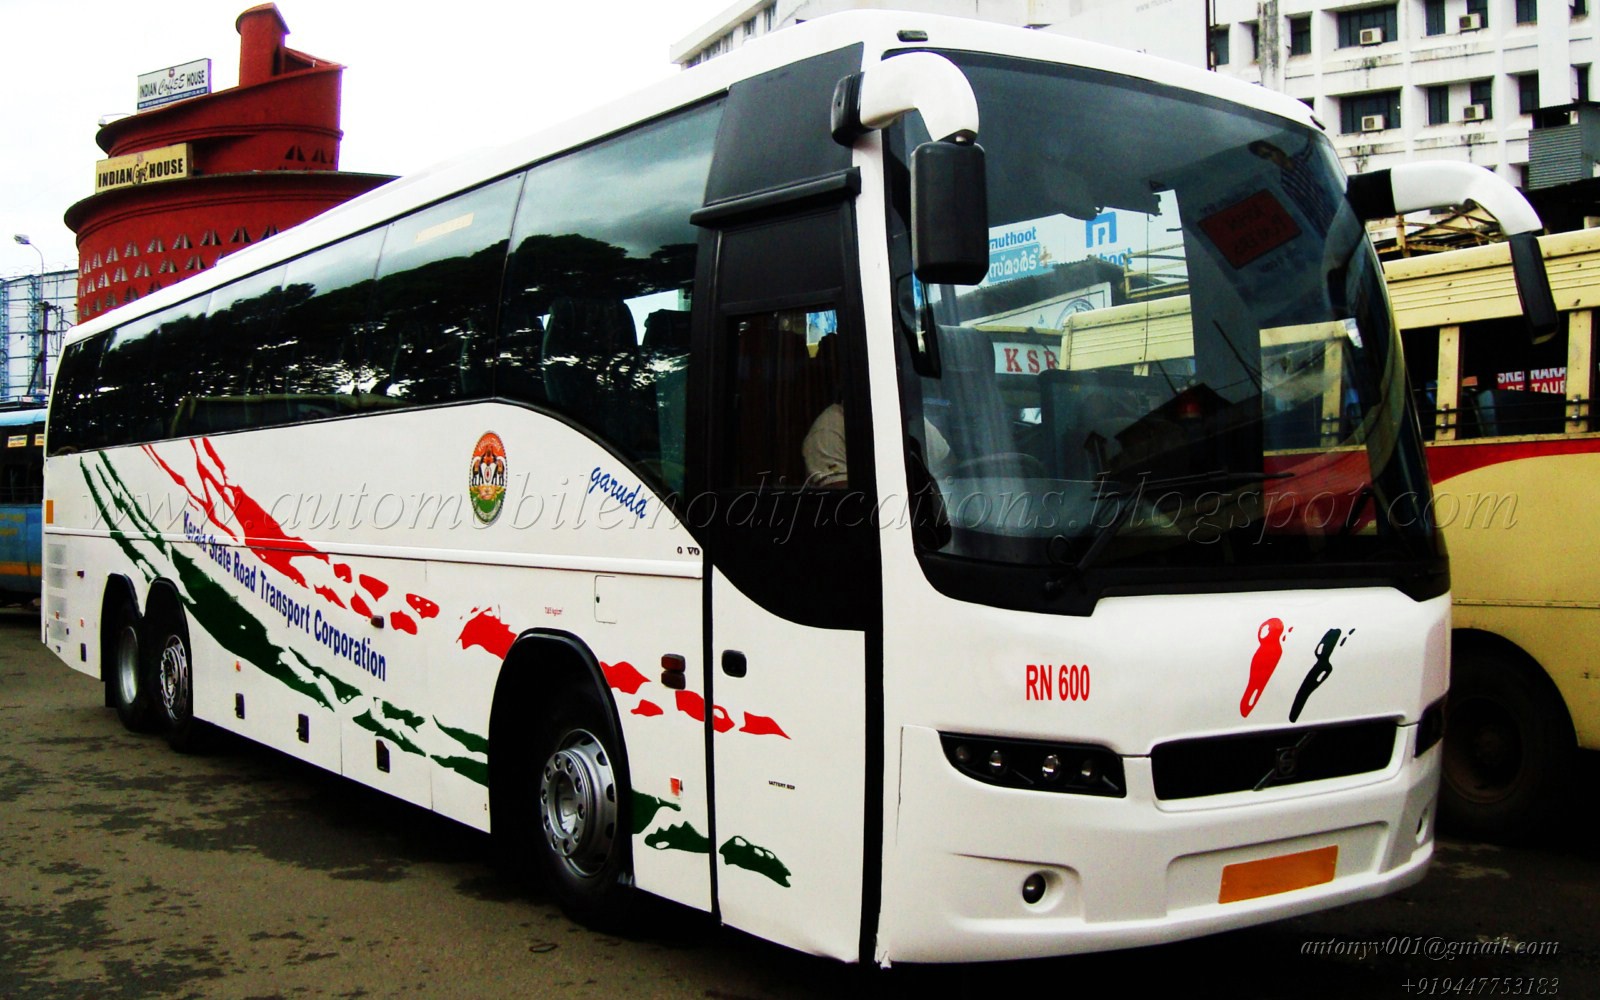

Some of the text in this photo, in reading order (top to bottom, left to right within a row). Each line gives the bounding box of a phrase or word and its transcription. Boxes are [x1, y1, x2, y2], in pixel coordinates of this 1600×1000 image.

[140, 82, 157, 98] INDIAN
[186, 69, 205, 87] HOUSE
[98, 167, 133, 189] INDIAN
[149, 158, 183, 178] HOUSE
[588, 466, 647, 519] garuda
[184, 510, 386, 682] Kerala State Road Transport Corporation
[1026, 664, 1090, 701] RN 600
